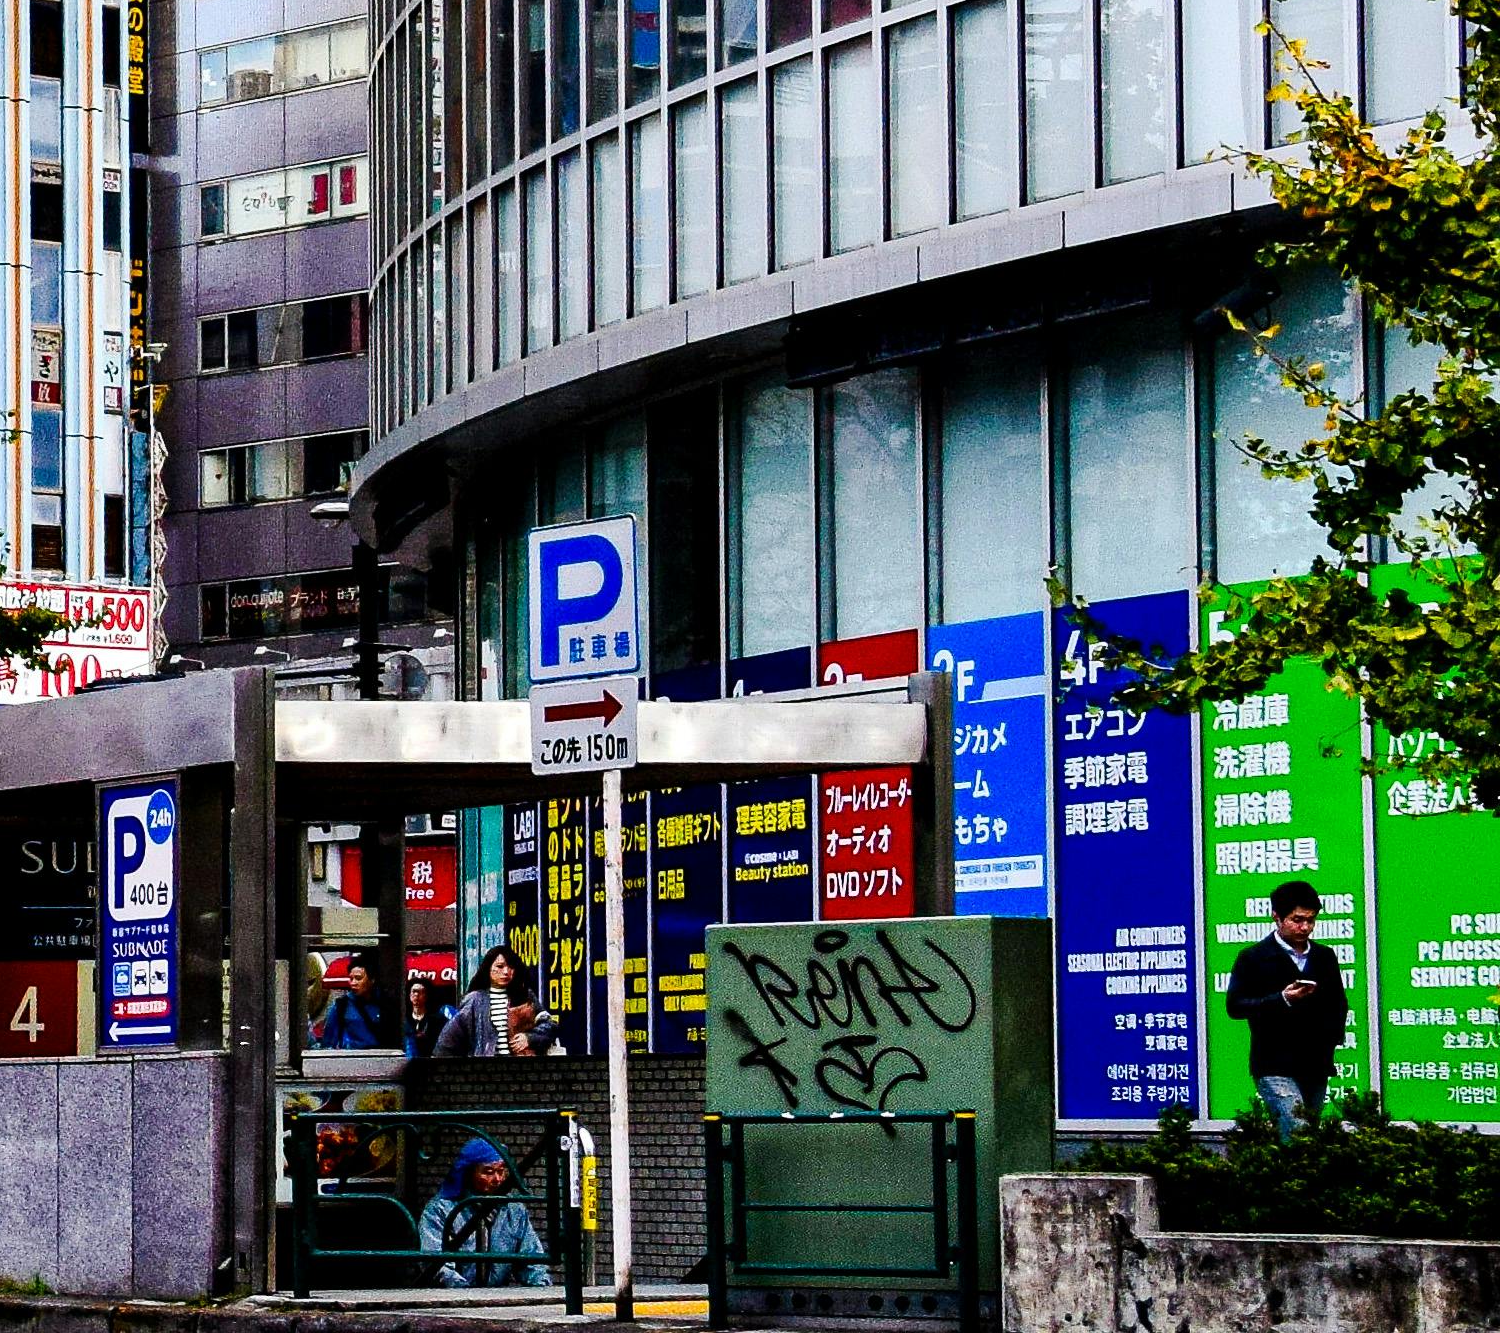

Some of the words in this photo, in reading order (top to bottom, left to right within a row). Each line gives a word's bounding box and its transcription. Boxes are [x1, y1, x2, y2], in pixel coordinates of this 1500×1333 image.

[540, 534, 623, 667] P
[568, 630, 631, 664] 駐車場
[1064, 709, 1147, 741] エアコン
[1212, 692, 1291, 733] 冷蔵庫
[540, 737, 581, 766] この先
[586, 734, 629, 763] 150m
[1213, 742, 1291, 779] 洗濯機
[1064, 751, 1148, 789] 季節家電
[150, 807, 172, 827] 24h
[735, 798, 806, 836] 理美容家電
[1065, 798, 1149, 836] 調理家電
[1214, 790, 1292, 828] 掃除機
[826, 825, 891, 857] オーディオ
[1215, 836, 1320, 877] 照明器具
[113, 815, 147, 910] P
[735, 865, 770, 882] Beauty
[772, 861, 808, 878] station
[130, 881, 169, 907] 400台
[826, 872, 859, 898] DVD
[864, 867, 902, 895] ソフト
[1451, 915, 1473, 935] PC
[112, 939, 168, 957] SUBNADE
[1419, 941, 1439, 961] PC
[1410, 966, 1460, 989] SERVICE
[9, 985, 44, 1042] 4
